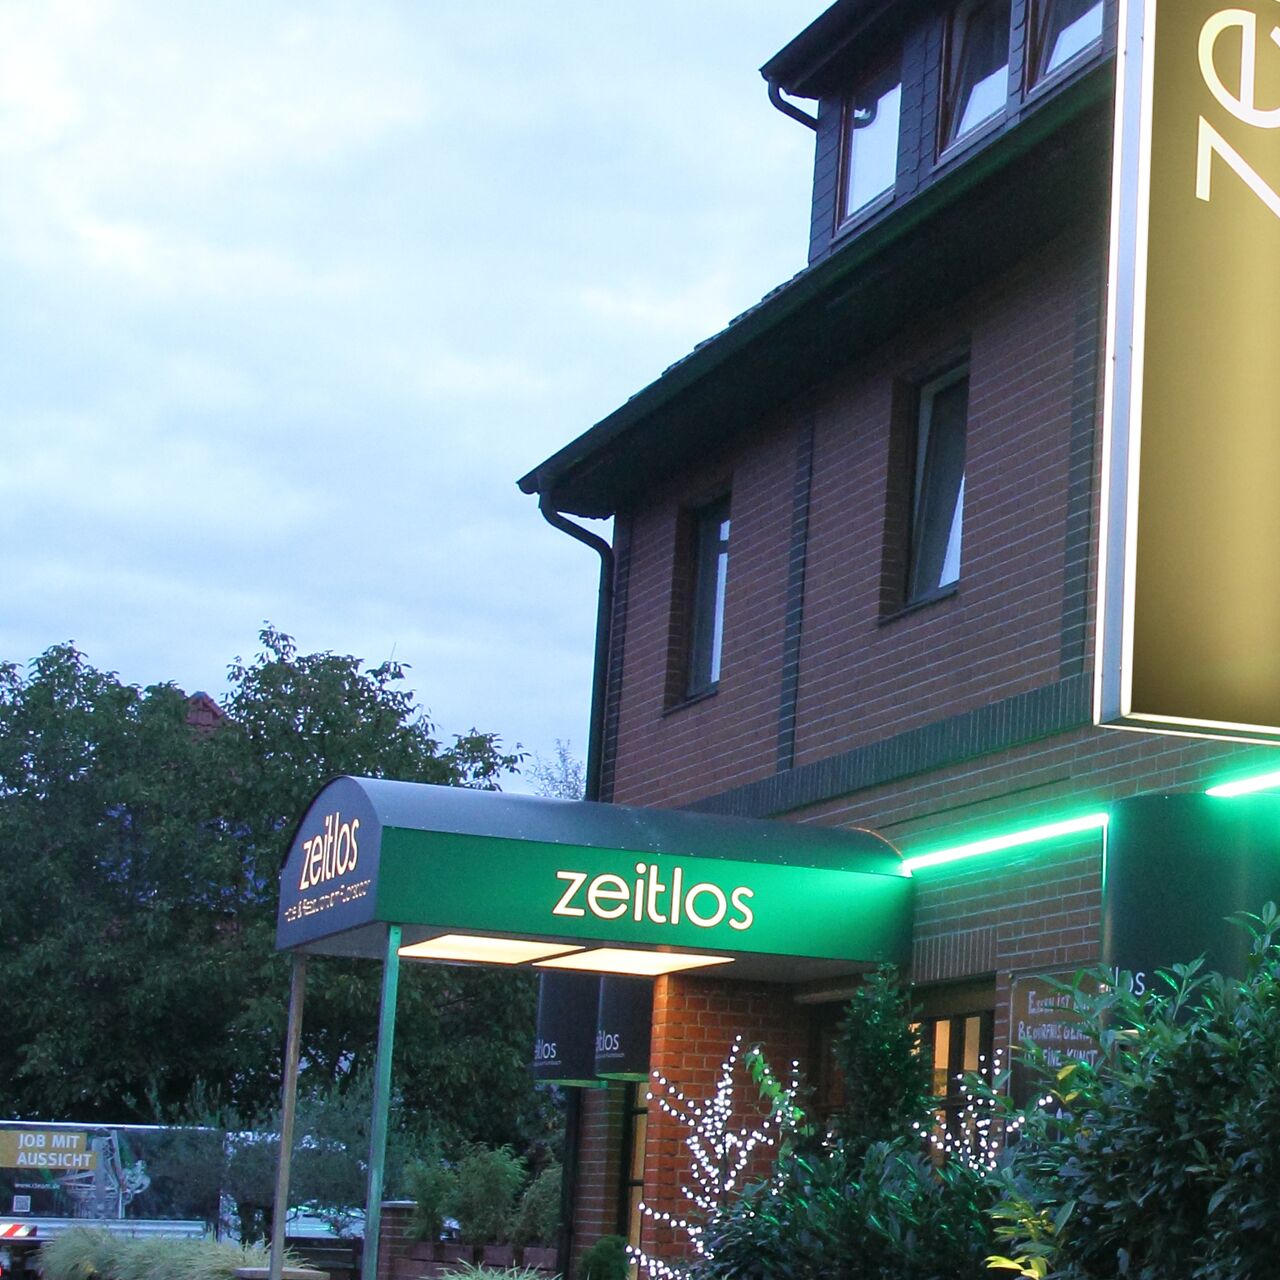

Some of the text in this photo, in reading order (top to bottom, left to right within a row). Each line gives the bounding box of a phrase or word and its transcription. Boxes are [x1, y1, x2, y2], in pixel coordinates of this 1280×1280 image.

[299, 811, 360, 891] zeitlos
[552, 862, 754, 931] zeitlos
[16, 1151, 92, 1167] AUSSICHT
[17, 1133, 81, 1149] JOB MIT
